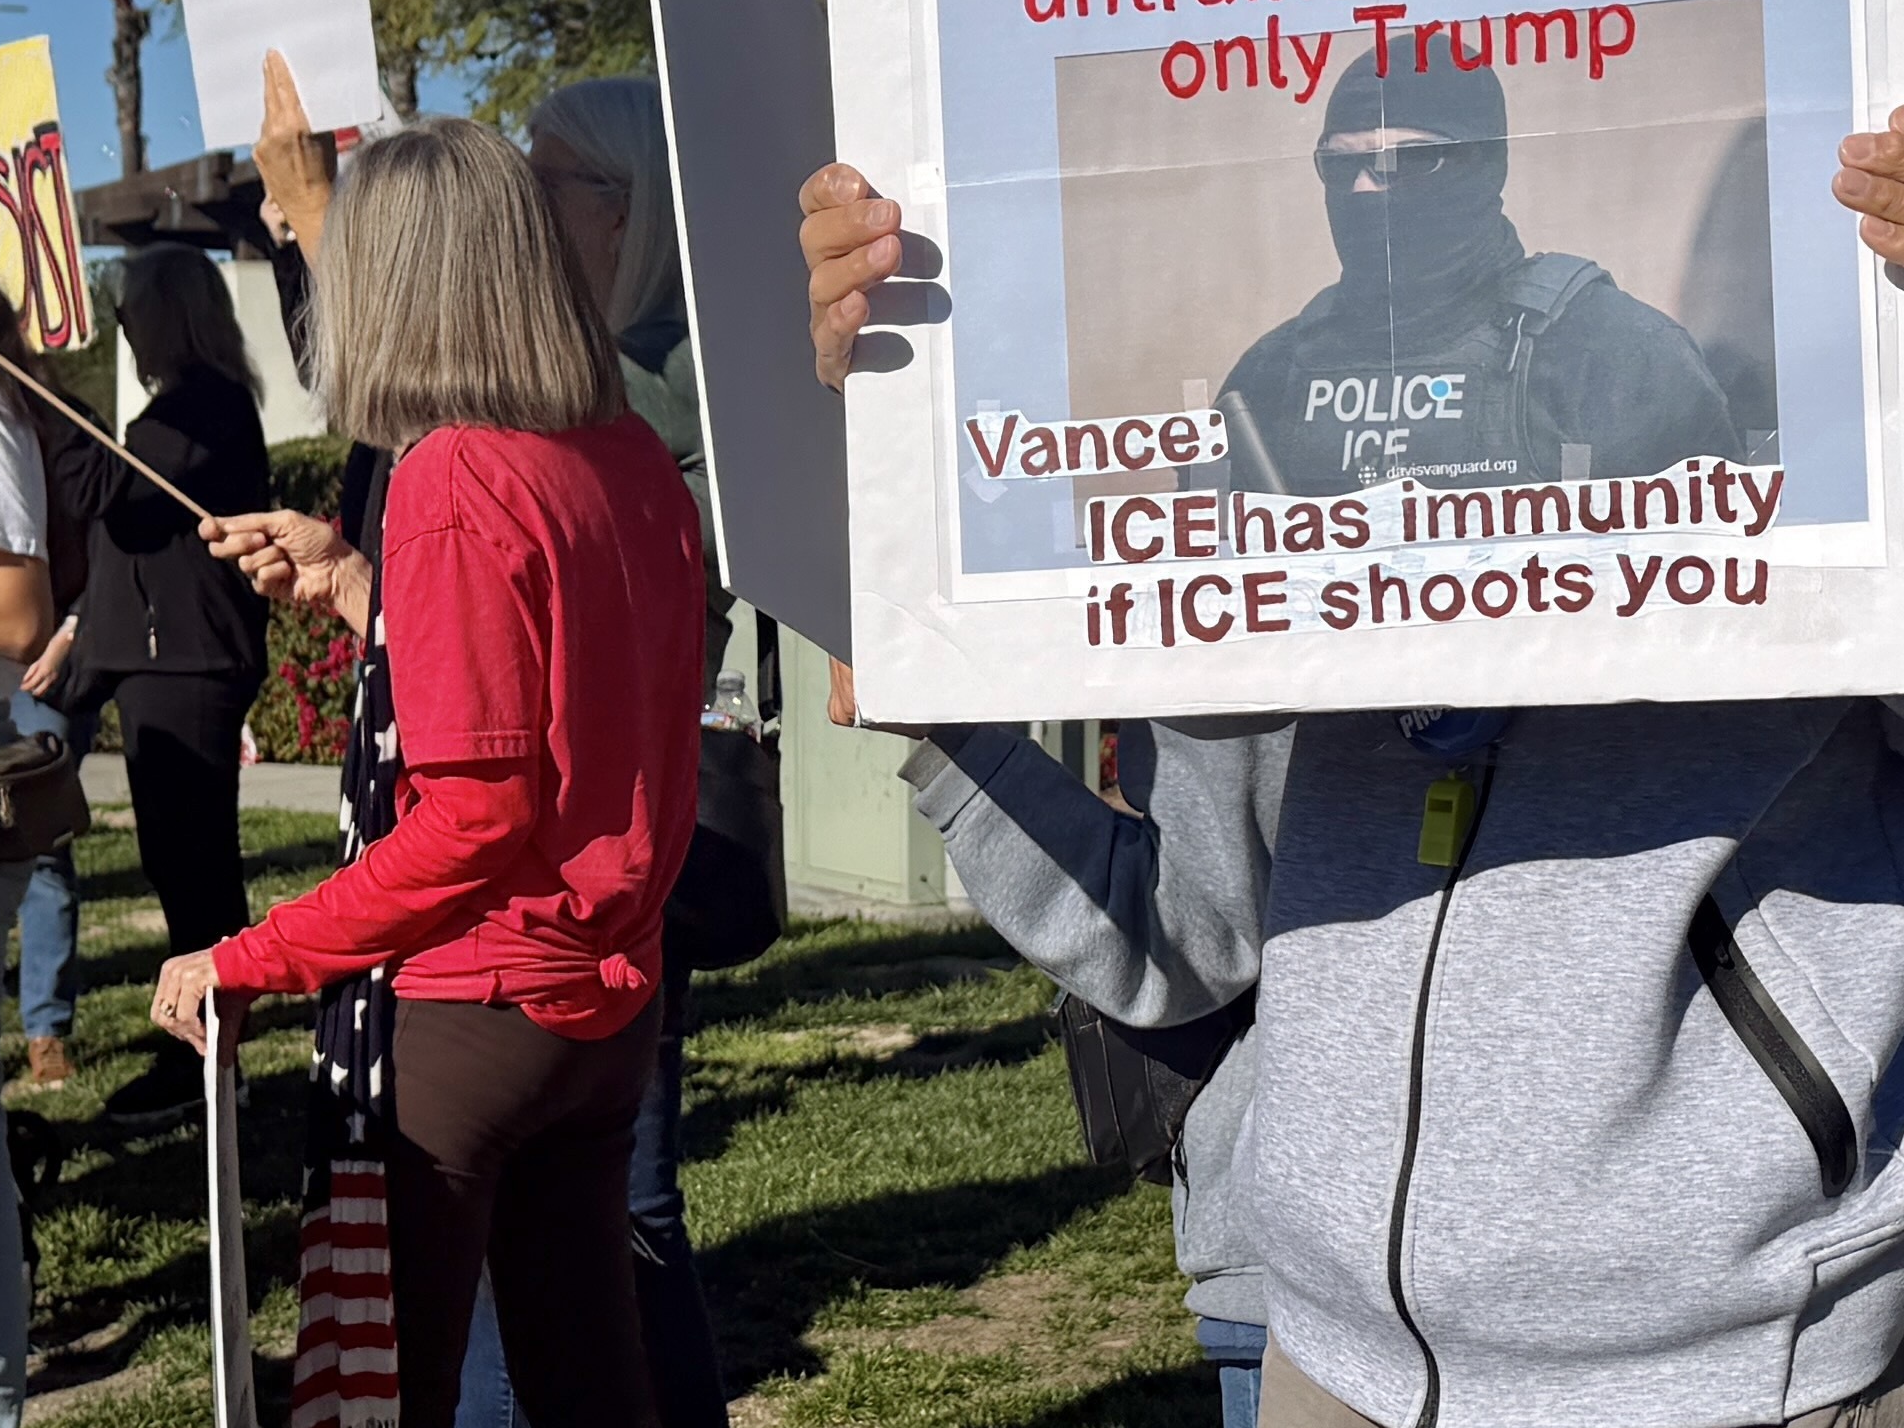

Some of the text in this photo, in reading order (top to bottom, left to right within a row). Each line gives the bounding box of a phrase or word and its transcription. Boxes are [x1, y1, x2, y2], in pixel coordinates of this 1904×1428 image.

[1161, 3, 1634, 102] only Trump
[1305, 374, 1466, 422] POLICE
[967, 411, 1227, 478] Vance:
[1091, 460, 1784, 564] ICE has immunity
[1086, 554, 1767, 646] if ICE shoots you
